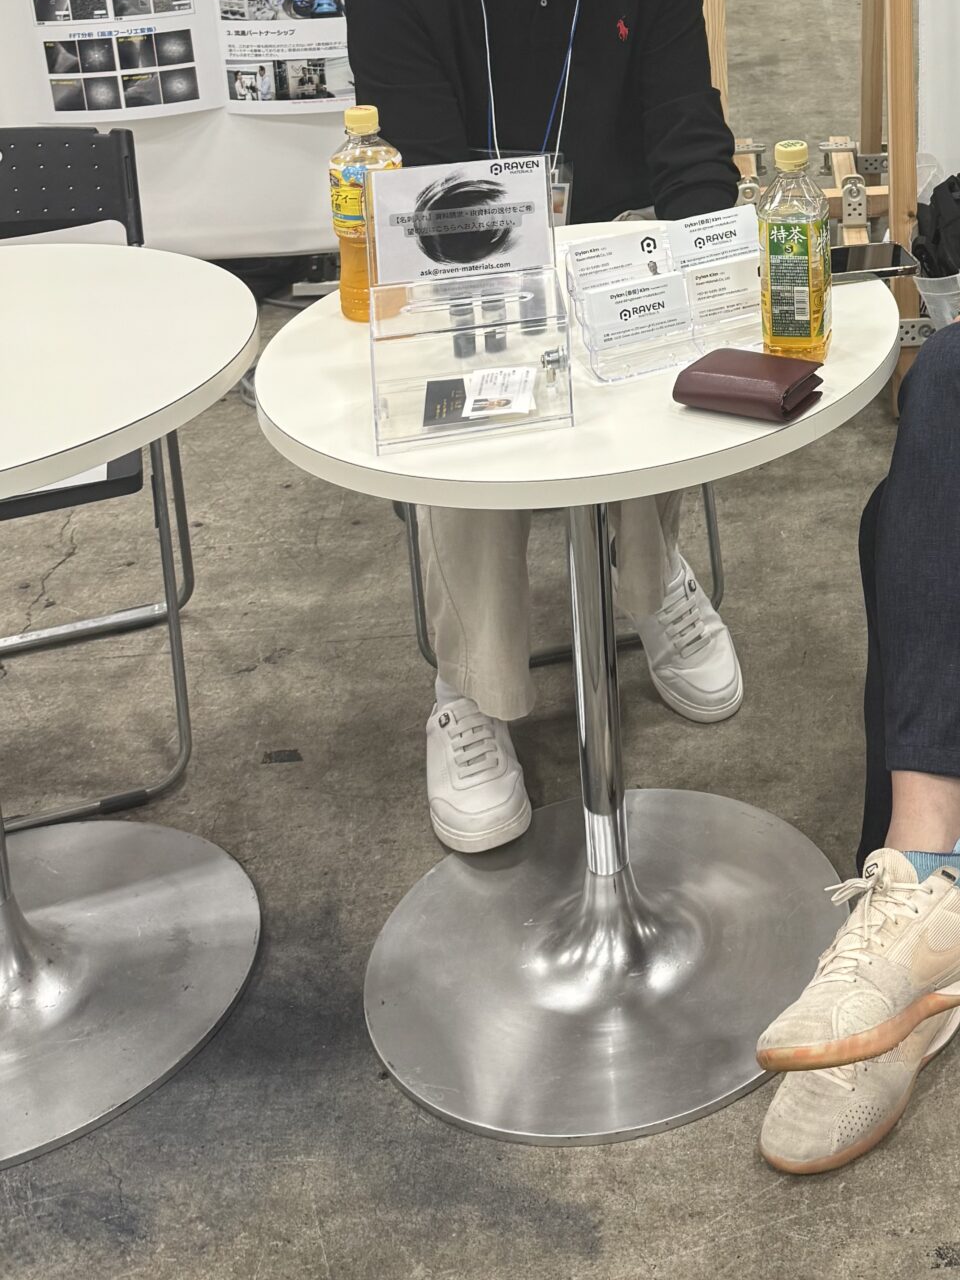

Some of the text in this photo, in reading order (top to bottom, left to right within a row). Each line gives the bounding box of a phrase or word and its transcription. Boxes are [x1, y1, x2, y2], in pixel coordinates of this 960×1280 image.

[503, 160, 540, 171] RAVEN
[706, 229, 737, 244] RAVEN
[770, 226, 807, 244] 特茶
[420, 261, 511, 277] ask@raven-materials.com
[632, 300, 665, 316] RAVEN
